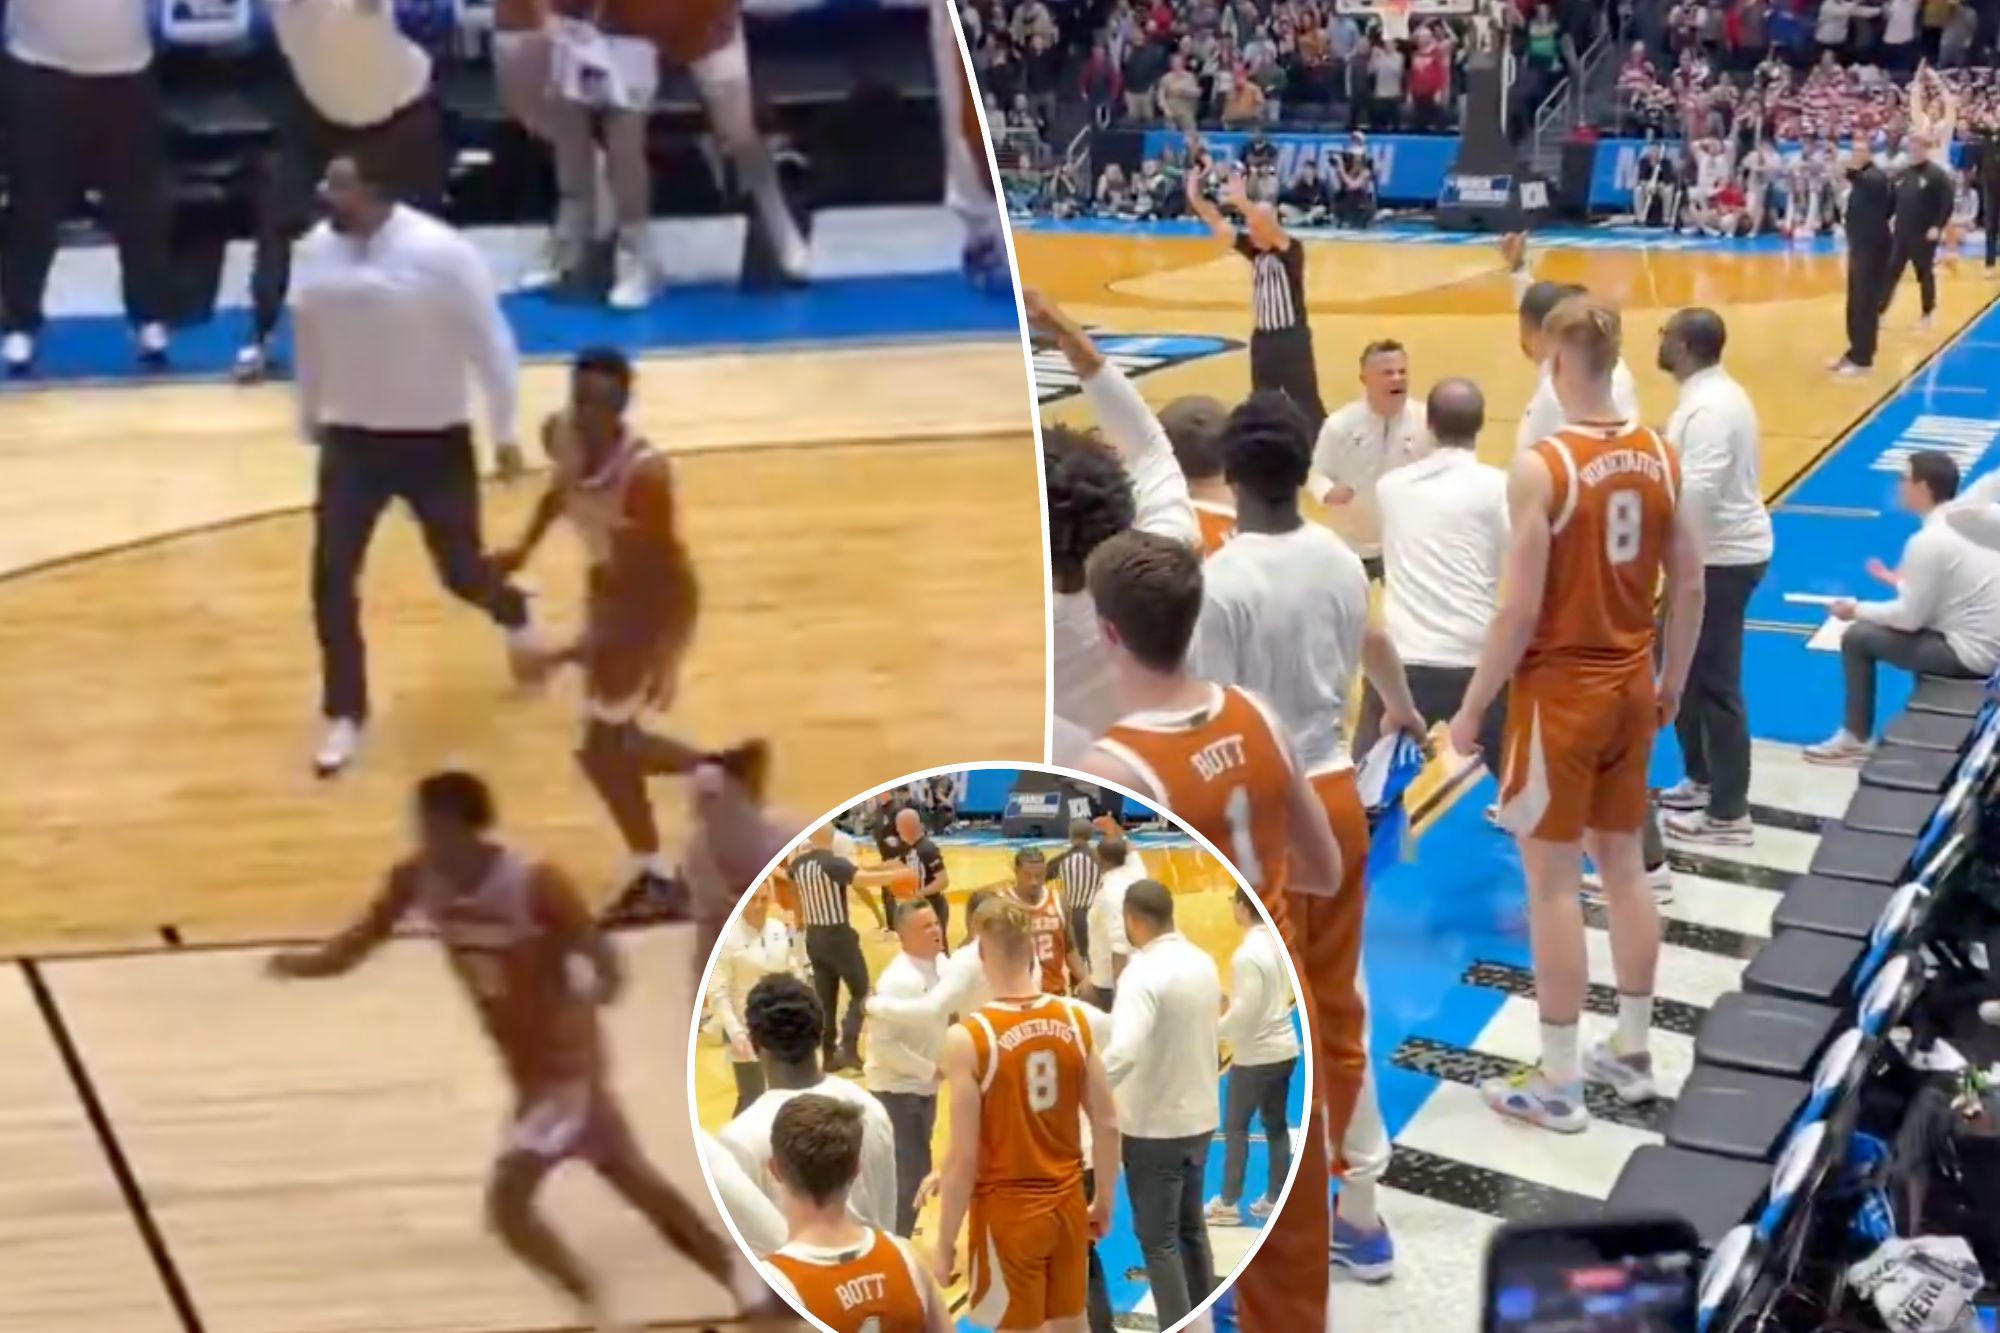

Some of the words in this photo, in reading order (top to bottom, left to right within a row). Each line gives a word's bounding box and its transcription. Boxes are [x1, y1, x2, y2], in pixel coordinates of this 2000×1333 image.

[1274, 140, 1396, 190] MARH
[1605, 490, 1642, 566] 8
[1189, 733, 1246, 782] BOTT
[1224, 785, 1266, 888] 1
[1026, 1049, 1059, 1113] 8
[834, 1272, 886, 1312] BOTT
